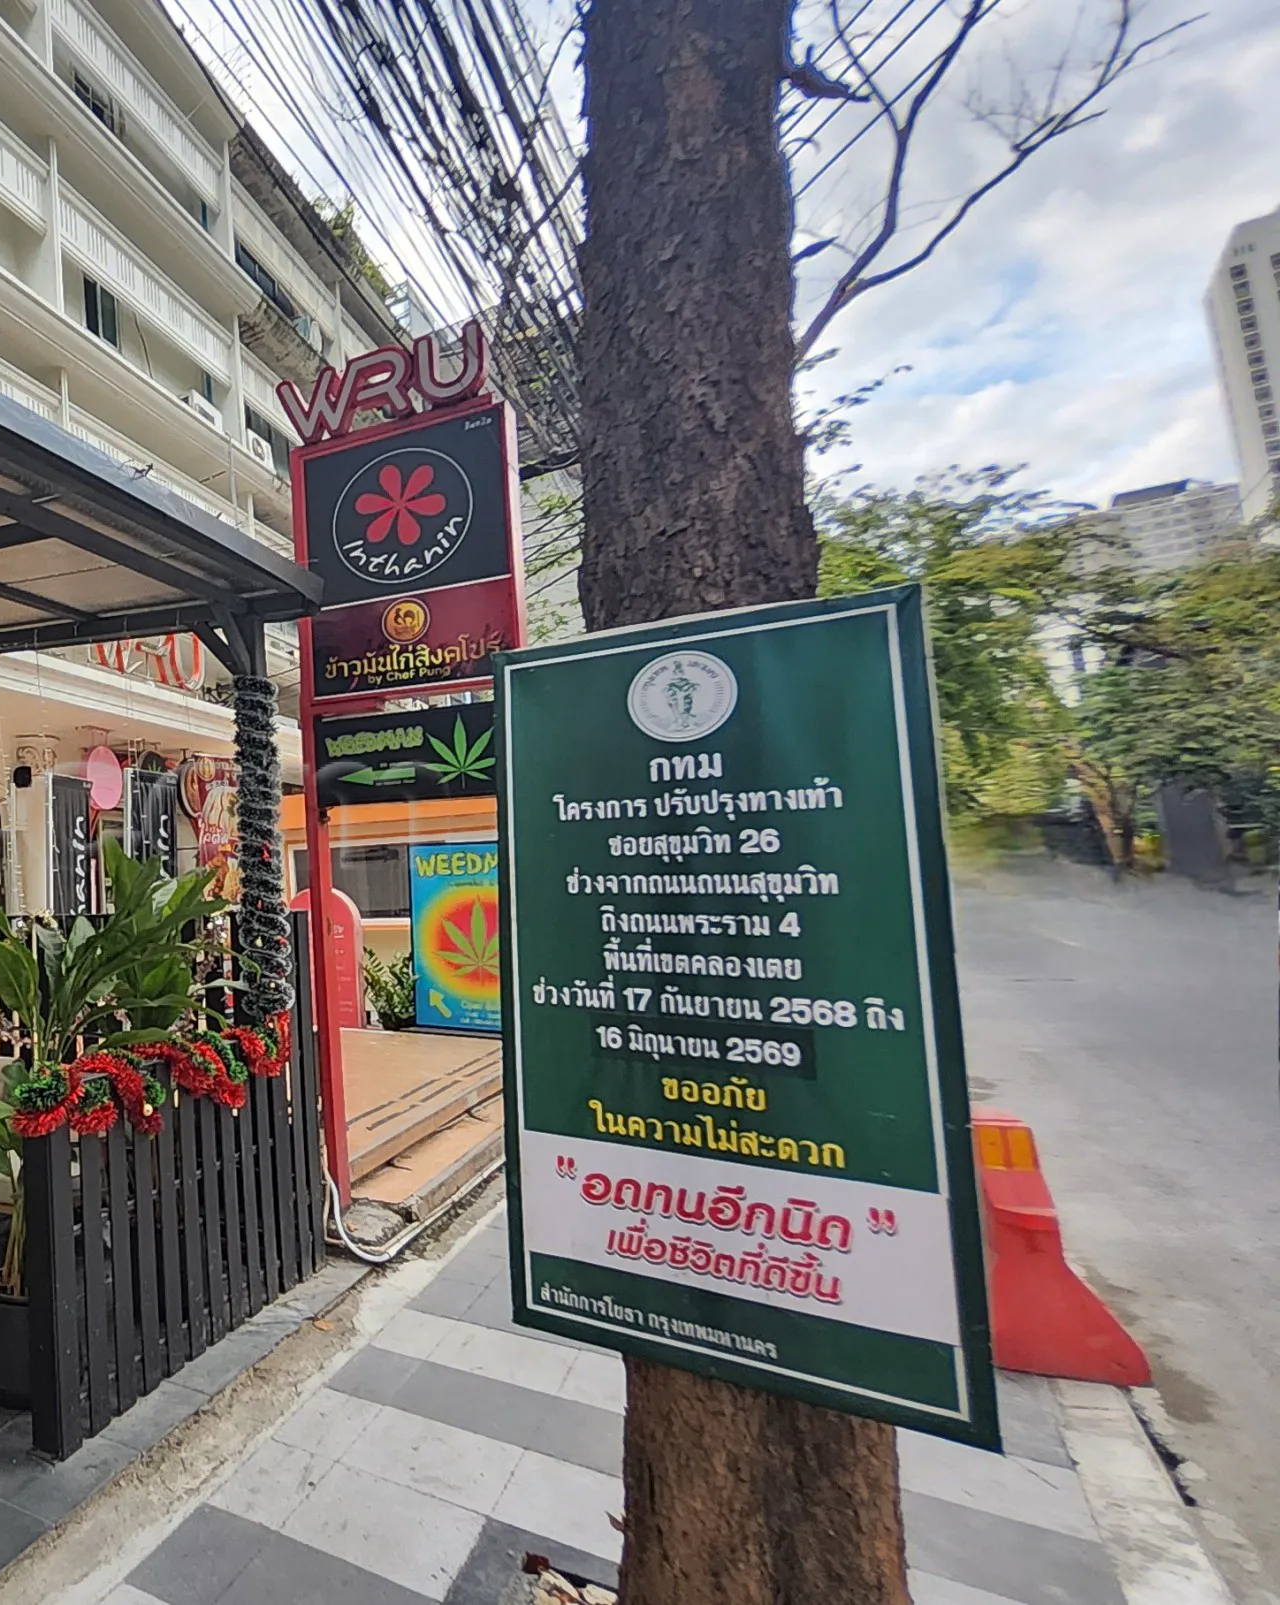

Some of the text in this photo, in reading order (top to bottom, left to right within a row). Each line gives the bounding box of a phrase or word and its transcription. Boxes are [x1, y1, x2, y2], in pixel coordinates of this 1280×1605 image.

[276, 319, 484, 442] WRU
[343, 515, 464, 575] Inthanin
[368, 665, 451, 685] by Chef Pung
[649, 753, 723, 782] กทม
[552, 777, 844, 822] โครงการ ปรับปรุงทางเท้า
[739, 828, 781, 855] 26
[415, 852, 499, 877] WEEDM
[566, 864, 840, 903] ช่วงจากถนนถนนสุขุมวิท
[601, 905, 801, 938] ถึงถนนพระราม 4
[602, 936, 803, 981] พื้นที่เขตคลองเตย
[532, 976, 905, 1031] ช่วงวันที่ 17 กันยายน 2568 ถึง
[596, 1023, 802, 1067] 16 มิถุนายน 2569
[661, 1076, 768, 1112] ขออภัย
[588, 1099, 846, 1170] ในความไม่สะดวก
[607, 1219, 843, 1304] เพื่อชีวิตที่ดีขึ้น
[540, 1283, 779, 1360] สำนักการโยธา กรุงเทพมหานคร
